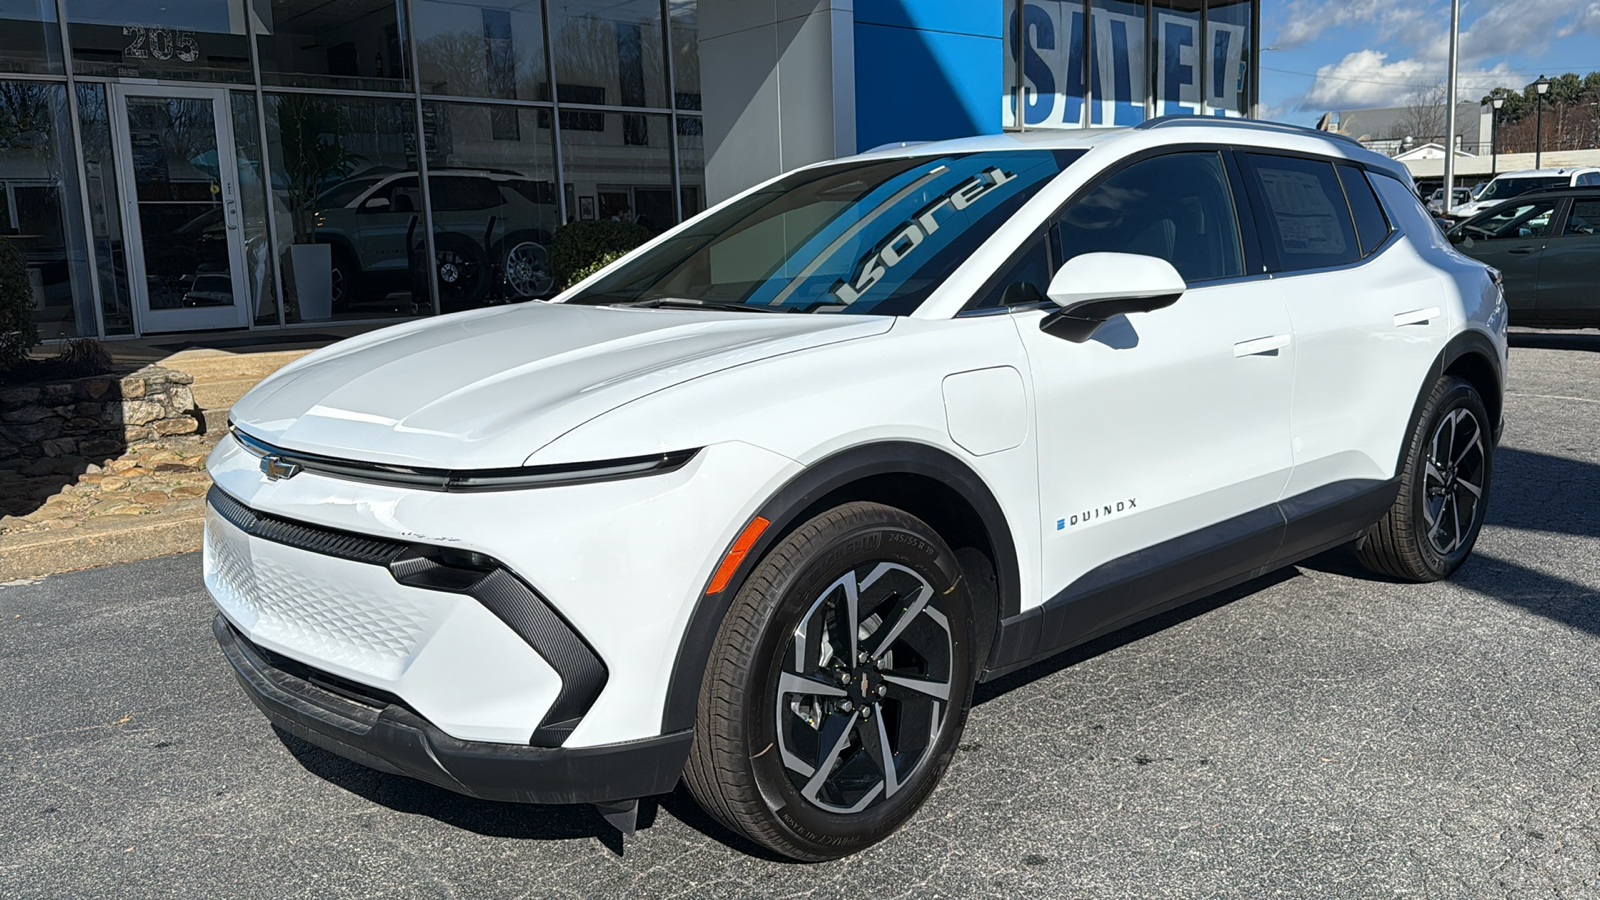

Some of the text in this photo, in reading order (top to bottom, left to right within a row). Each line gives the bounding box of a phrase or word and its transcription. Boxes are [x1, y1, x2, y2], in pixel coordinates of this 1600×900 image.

[122, 22, 200, 62] 205
[1009, 3, 1231, 125] SALE!
[1056, 497, 1138, 531] EQUINOX
[888, 533, 935, 555] 245/55 R 19
